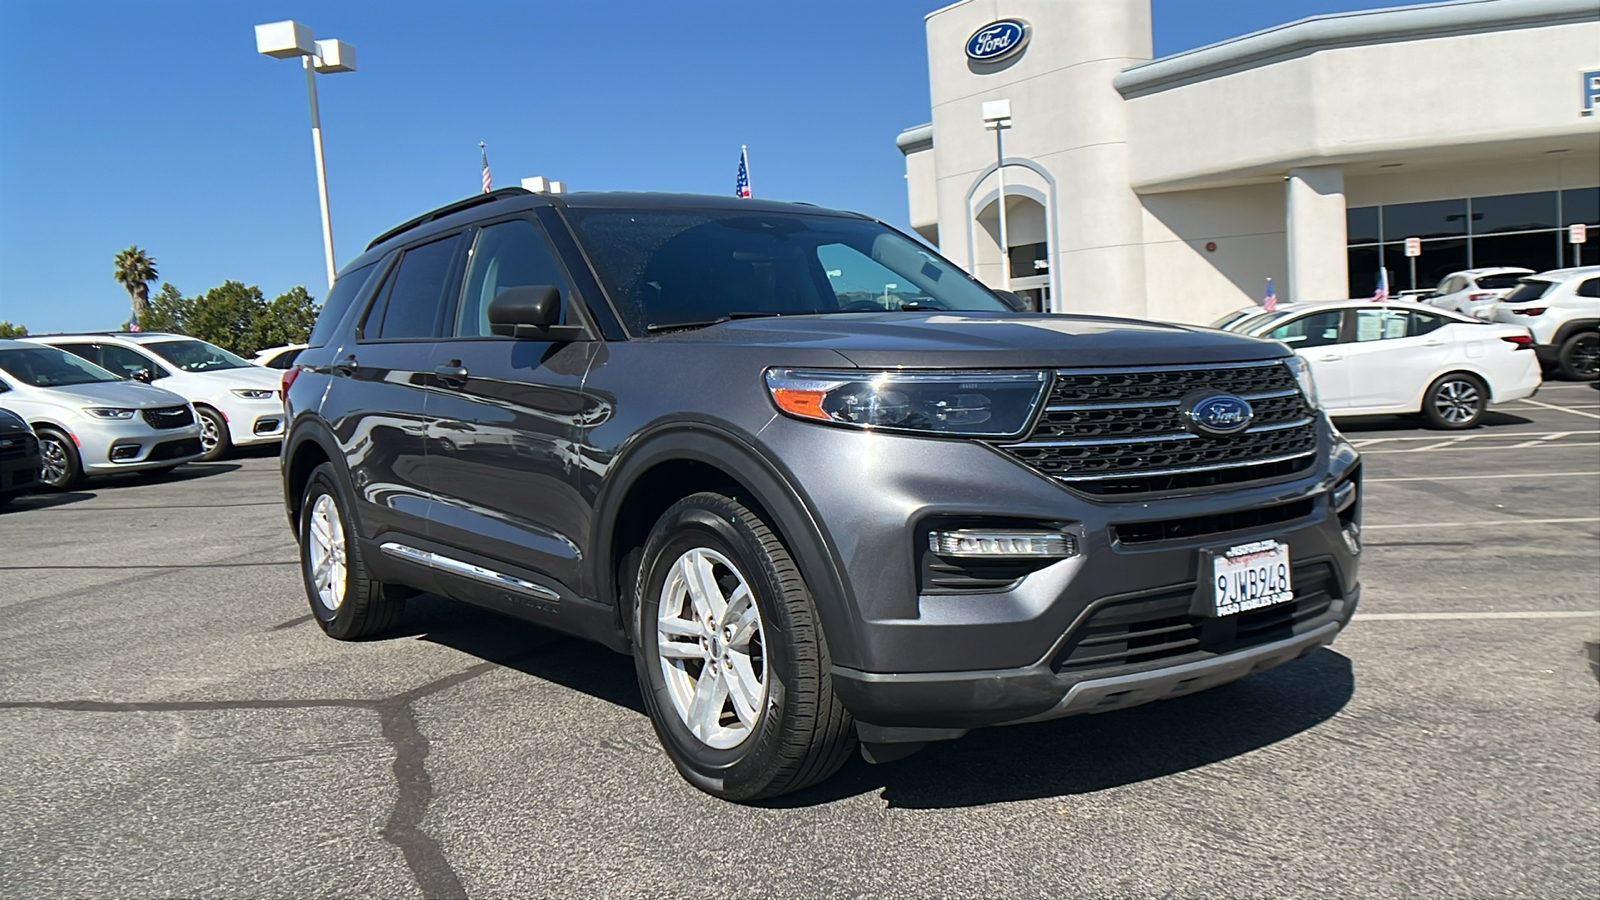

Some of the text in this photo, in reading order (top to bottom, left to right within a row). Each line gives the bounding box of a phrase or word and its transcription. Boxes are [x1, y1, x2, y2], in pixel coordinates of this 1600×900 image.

[975, 27, 1011, 54] Ford
[1209, 403, 1242, 424] Ford
[1218, 563, 1287, 606] 9JWB948
